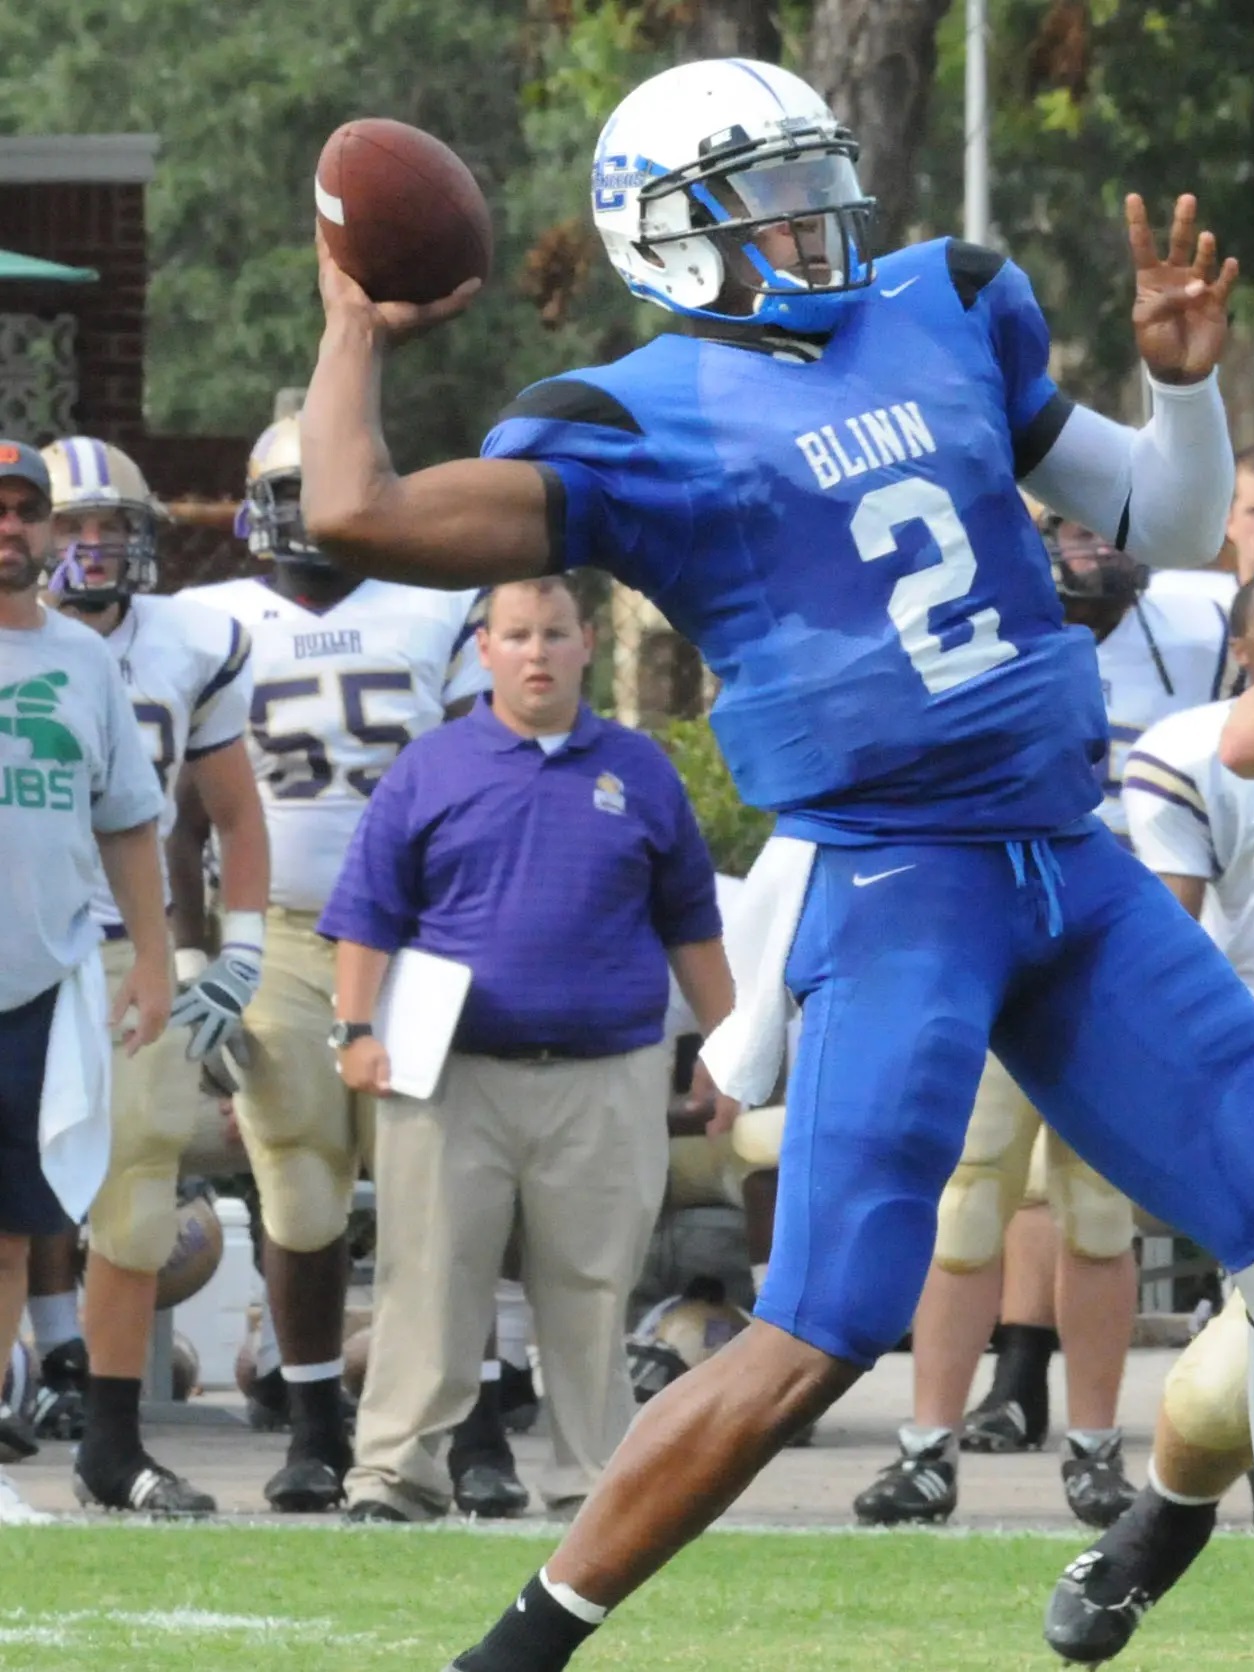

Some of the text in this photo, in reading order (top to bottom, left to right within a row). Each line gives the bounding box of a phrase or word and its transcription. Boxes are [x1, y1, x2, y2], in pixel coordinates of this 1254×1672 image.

[794, 400, 937, 490] BLINN
[849, 476, 1020, 696] 2
[293, 629, 364, 660] BUTLER
[249, 671, 413, 800] 55
